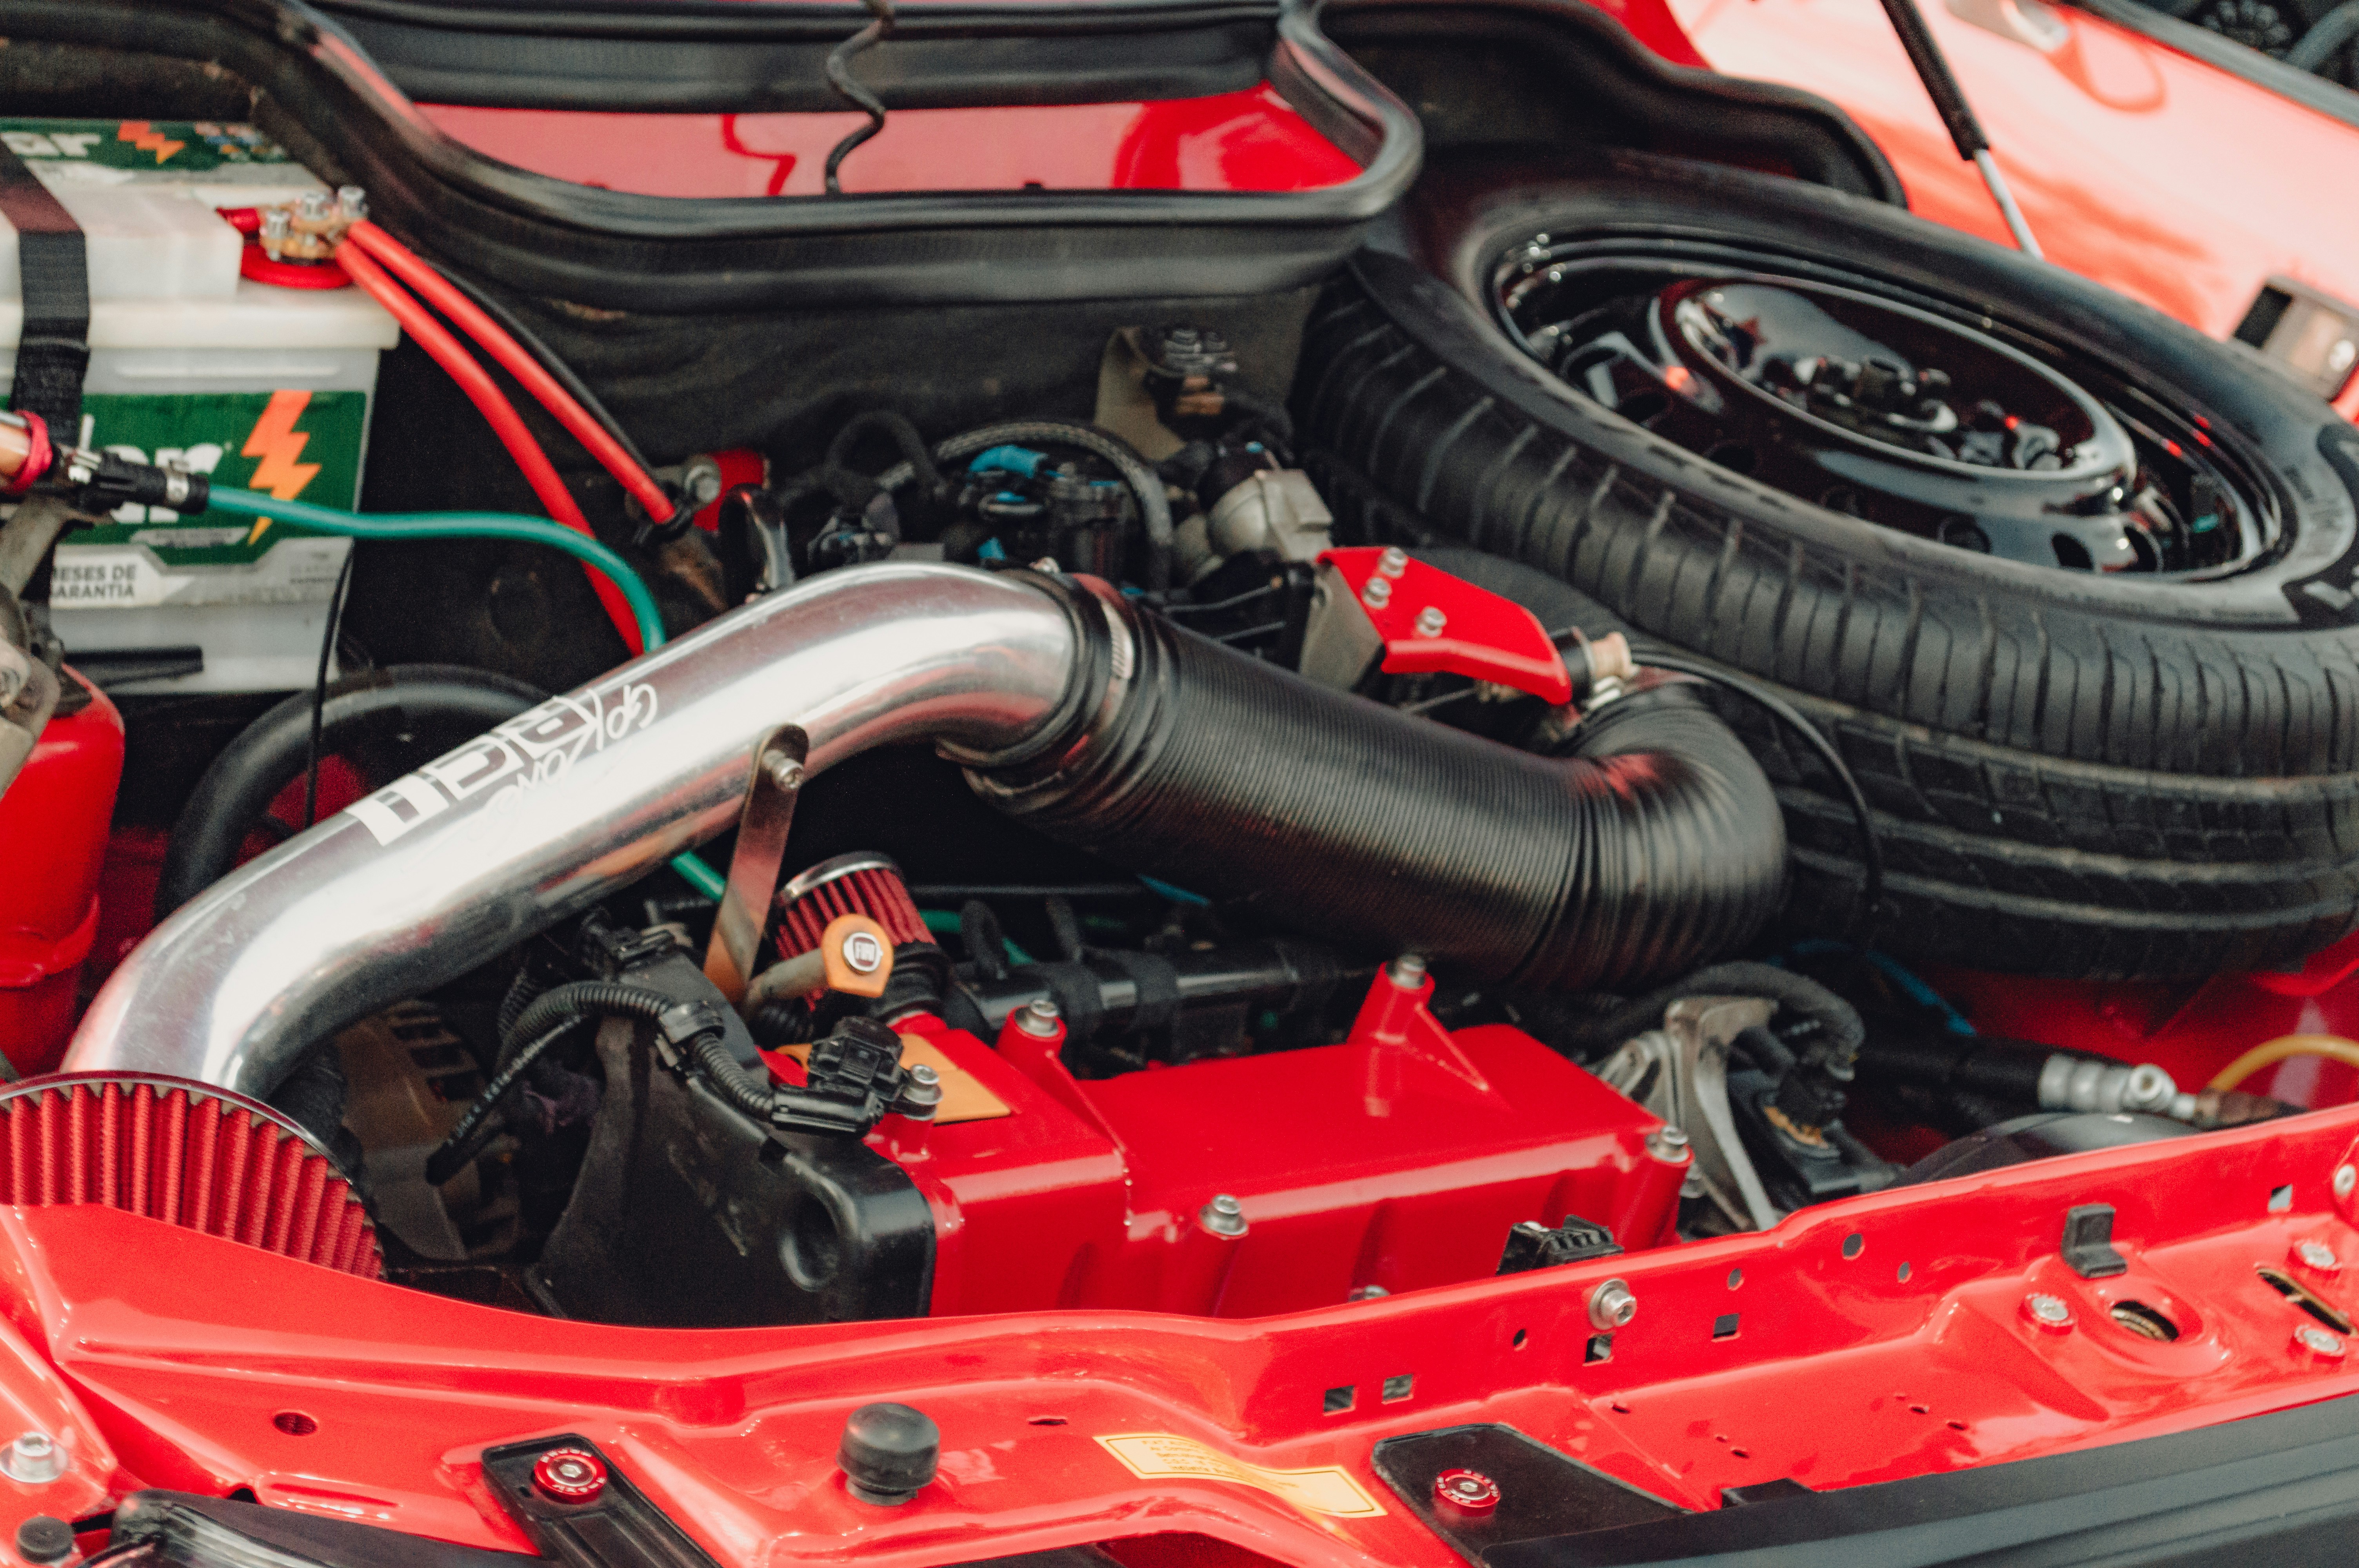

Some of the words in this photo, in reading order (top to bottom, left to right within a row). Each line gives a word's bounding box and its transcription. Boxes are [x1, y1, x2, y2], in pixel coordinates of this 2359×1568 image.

[53, 565, 106, 582] ESES
[112, 564, 136, 581] DE
[53, 584, 134, 599] ARANTIA
